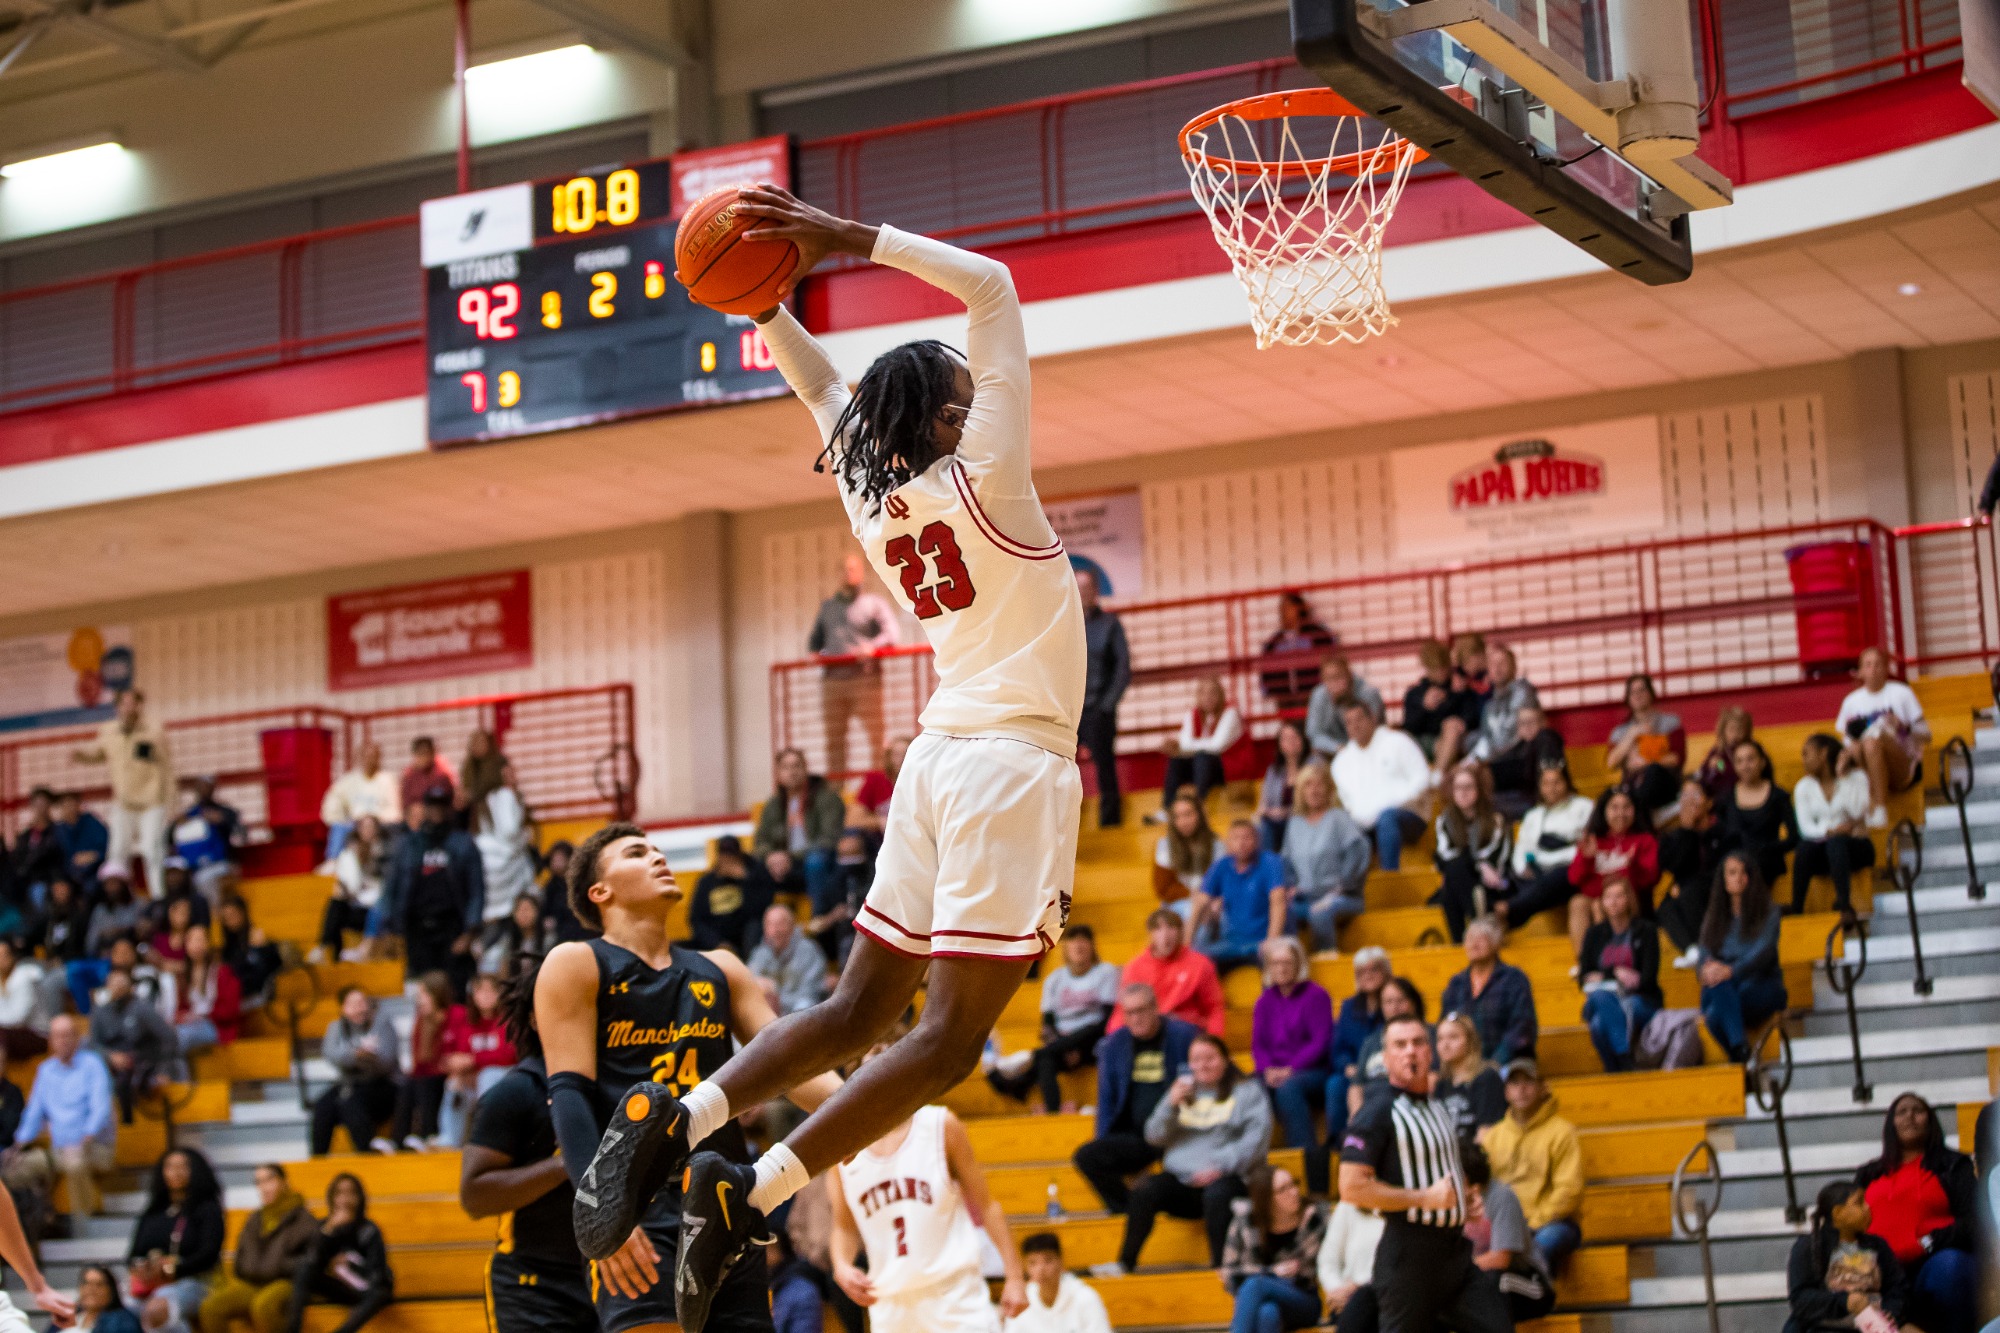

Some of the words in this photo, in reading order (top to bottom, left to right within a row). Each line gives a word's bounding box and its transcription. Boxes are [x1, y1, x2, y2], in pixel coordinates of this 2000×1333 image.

[552, 169, 640, 233] 10.8
[447, 254, 519, 288] TITANS
[588, 271, 618, 318] 2
[457, 282, 520, 340] 92
[460, 371, 488, 414] 7
[498, 370, 521, 407] 3
[1451, 461, 1516, 509] PAPA
[885, 520, 976, 620] 23
[606, 1016, 726, 1048] Manchester
[650, 1048, 702, 1098] 24
[858, 1177, 933, 1218] TITANS
[892, 1215, 909, 1257] 2
